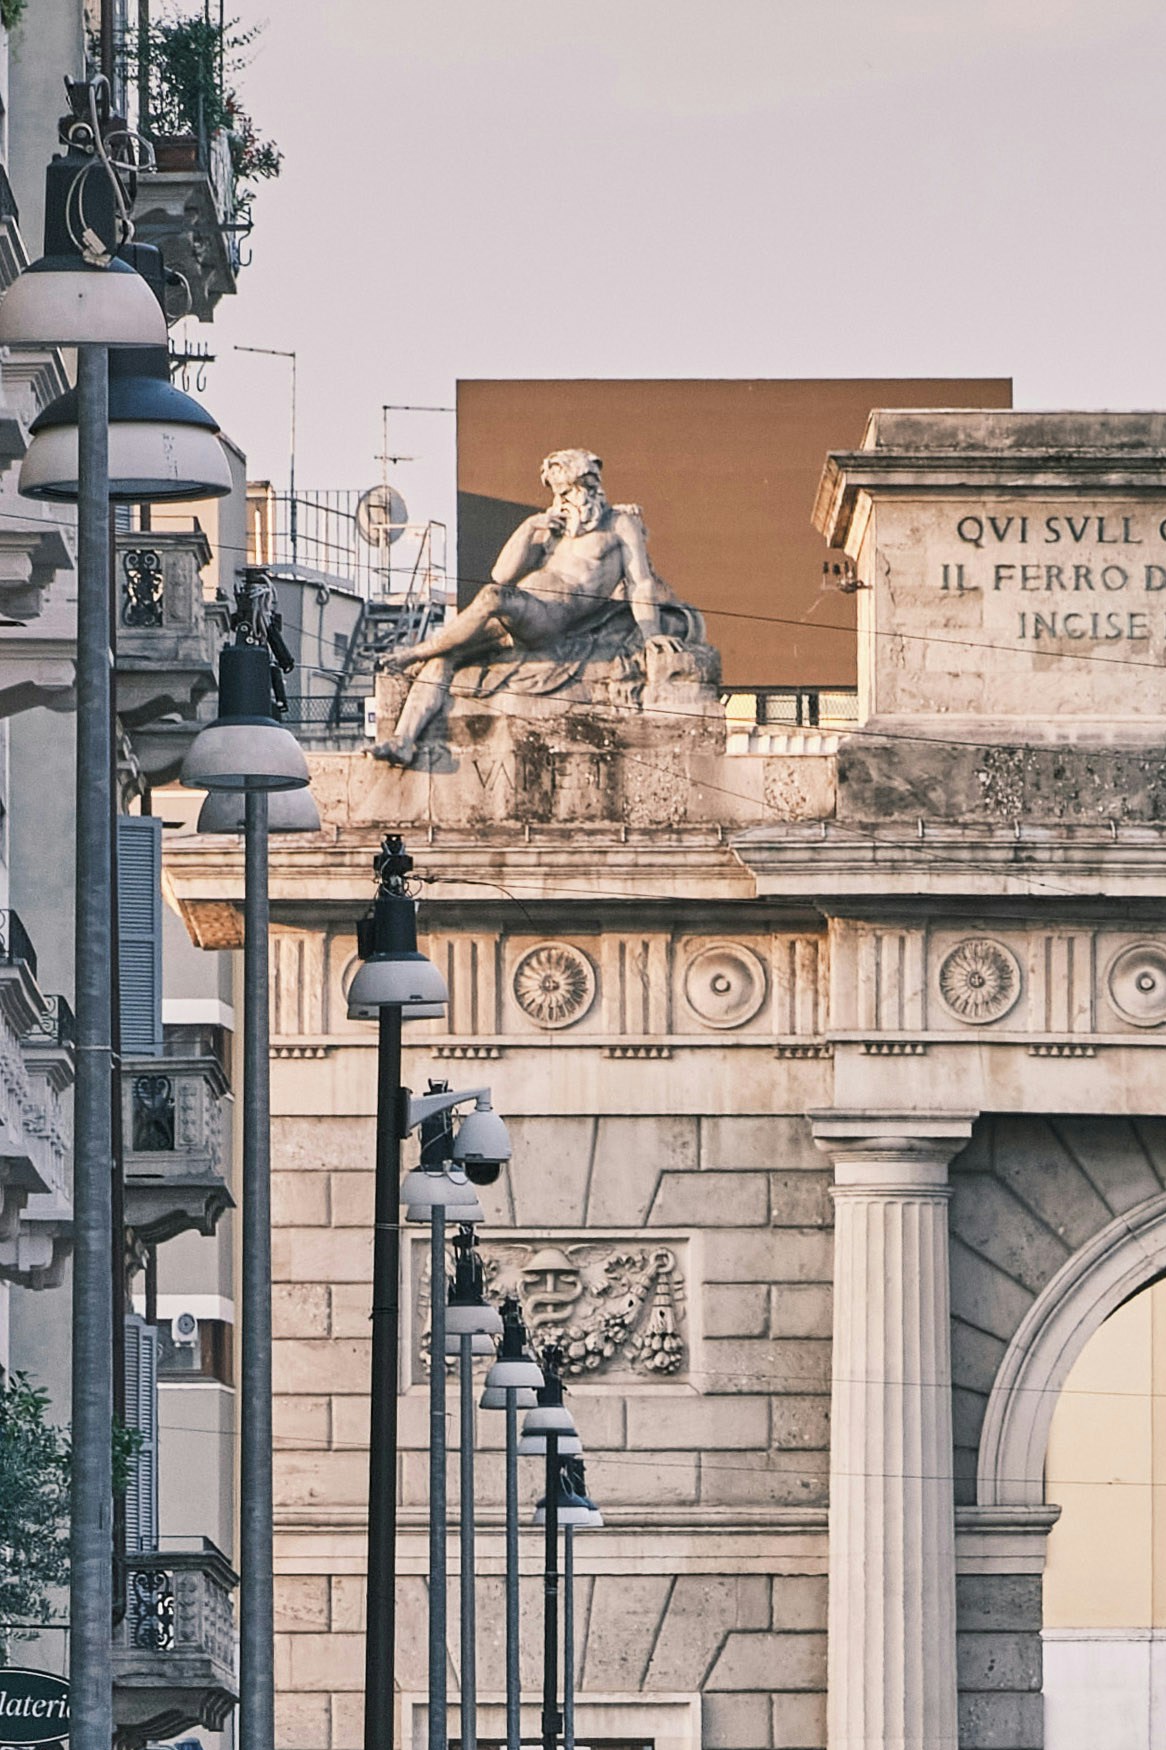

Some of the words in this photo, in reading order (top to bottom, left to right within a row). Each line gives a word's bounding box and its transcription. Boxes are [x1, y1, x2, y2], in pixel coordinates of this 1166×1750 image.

[957, 516, 1029, 548] QVI
[1044, 516, 1143, 544] SVLL
[940, 563, 979, 591] IL
[993, 564, 1129, 592] FERRO
[1017, 611, 1149, 640] INCISE
